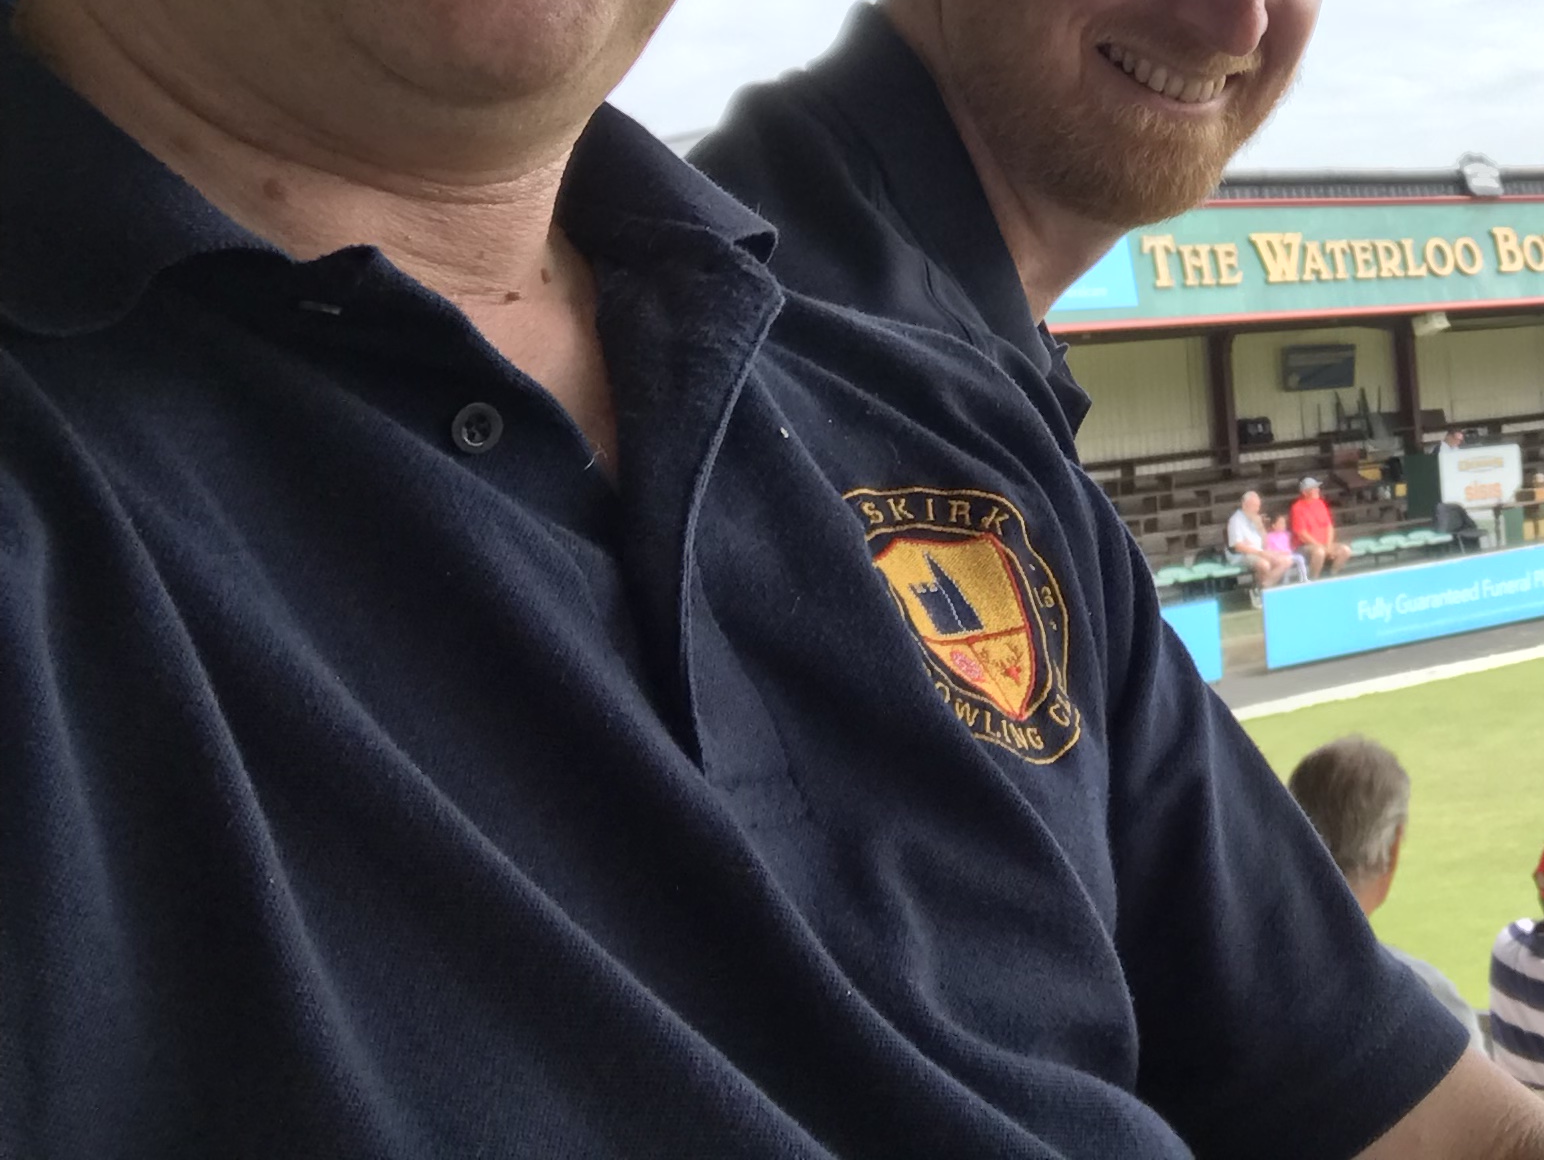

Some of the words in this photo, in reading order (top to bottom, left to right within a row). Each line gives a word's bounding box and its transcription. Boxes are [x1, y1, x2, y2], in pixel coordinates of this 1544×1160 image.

[1357, 596, 1394, 623] Fully
[1395, 581, 1481, 615] Guaranteed
[1481, 571, 1531, 599] Funeral
